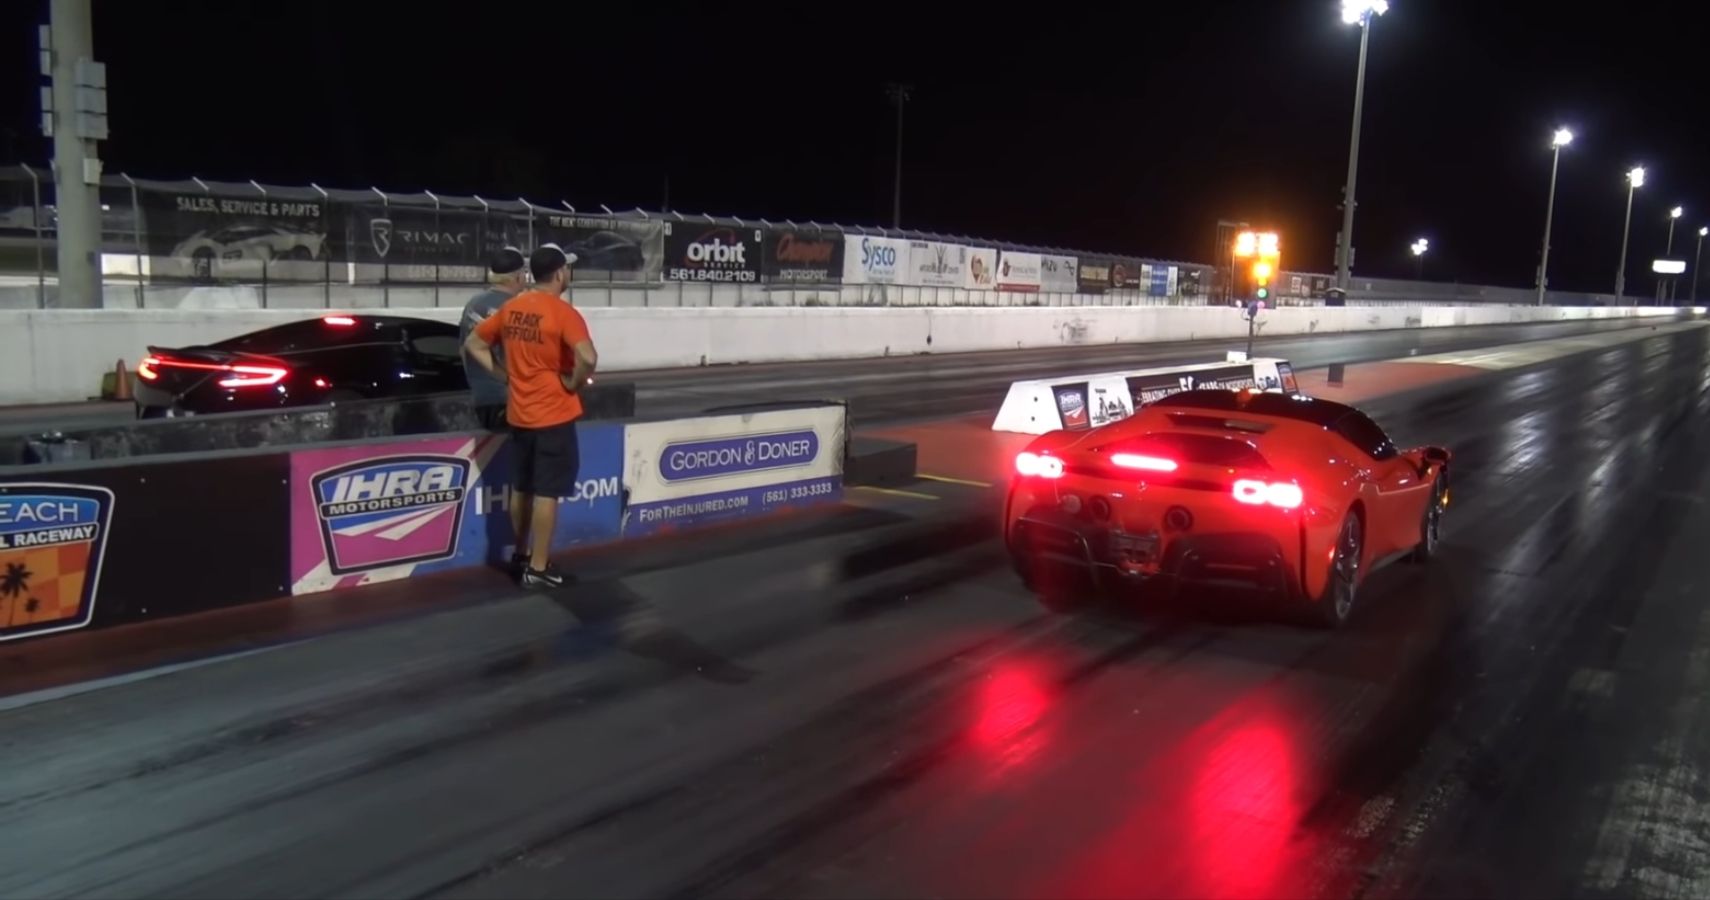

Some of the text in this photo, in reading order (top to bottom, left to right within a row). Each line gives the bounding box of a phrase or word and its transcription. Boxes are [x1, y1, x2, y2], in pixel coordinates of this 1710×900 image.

[176, 196, 320, 217] SALES, SERVICE & PARTS
[396, 230, 471, 244] RIMAC
[687, 238, 746, 263] orbit
[861, 238, 896, 271] Sysco
[670, 268, 756, 281] 561.840.2109
[780, 269, 828, 280] MOTORSPORT
[670, 440, 810, 471] GORDON & DONER
[332, 466, 454, 503] IHRA
[762, 492, 788, 505] (561)
[790, 482, 832, 499] 333-3333
[0, 502, 78, 523] EACH
[329, 490, 456, 515] MOTORSPORTS
[14, 526, 94, 547] RACEWAY
